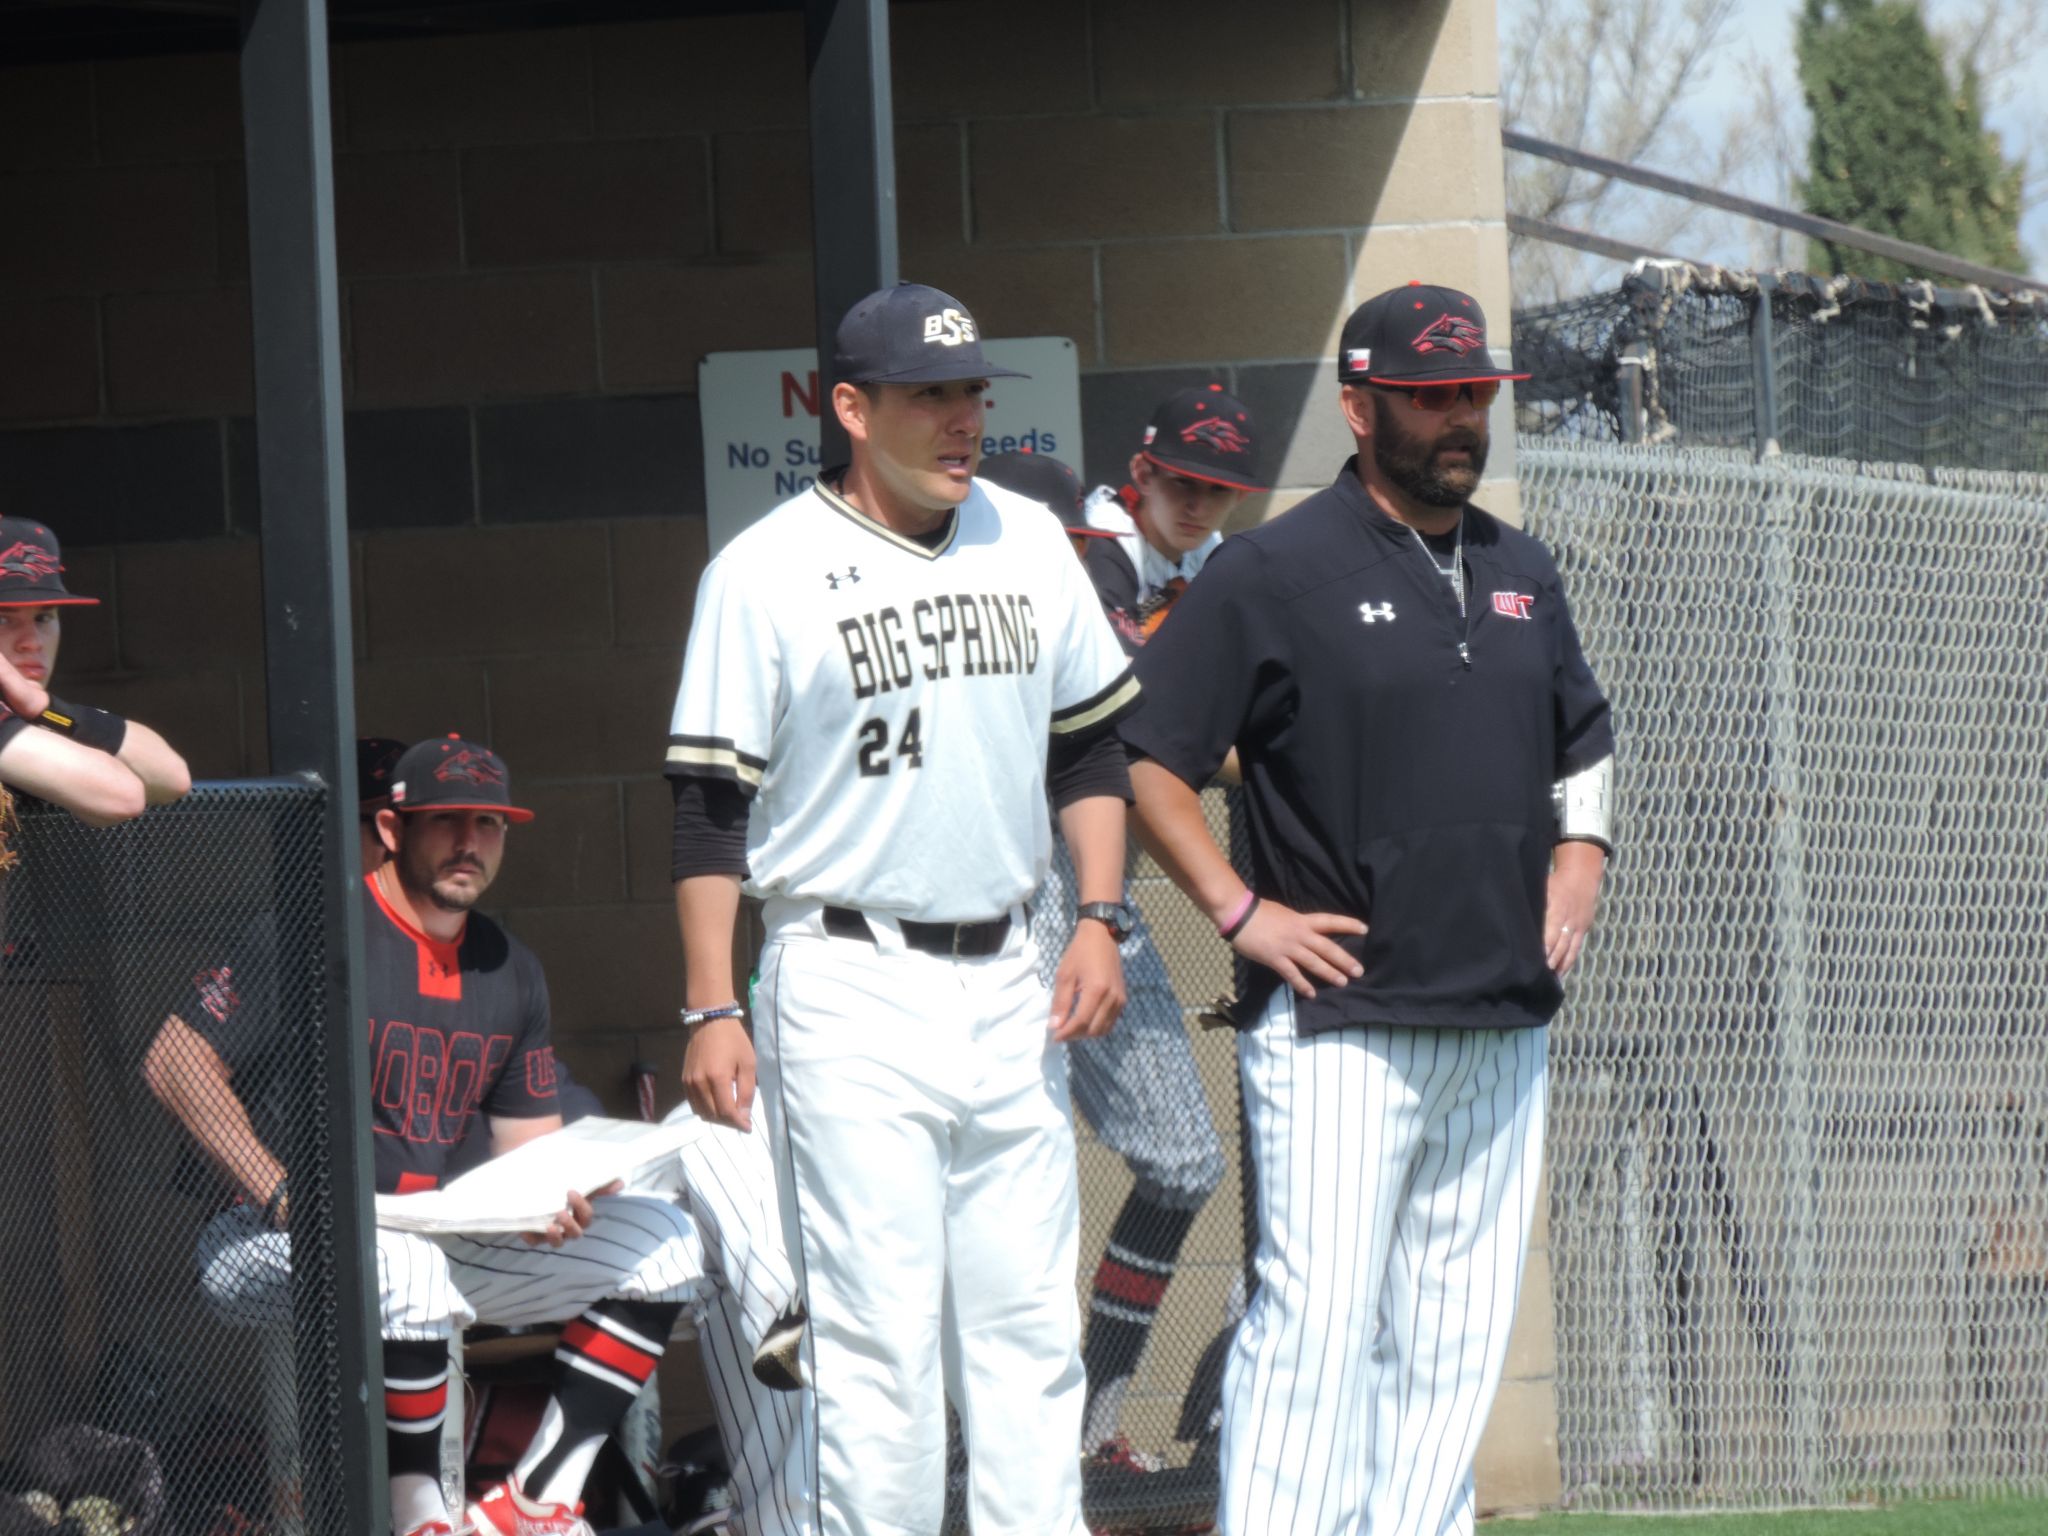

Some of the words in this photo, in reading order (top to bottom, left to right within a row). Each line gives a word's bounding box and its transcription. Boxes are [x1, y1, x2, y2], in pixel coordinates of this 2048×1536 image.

[727, 441, 770, 469] No
[980, 428, 1057, 457] eeds
[836, 606, 913, 700] BIG
[912, 593, 1039, 681] SPRING
[857, 706, 923, 777] 24
[368, 1018, 513, 1143] OBO
